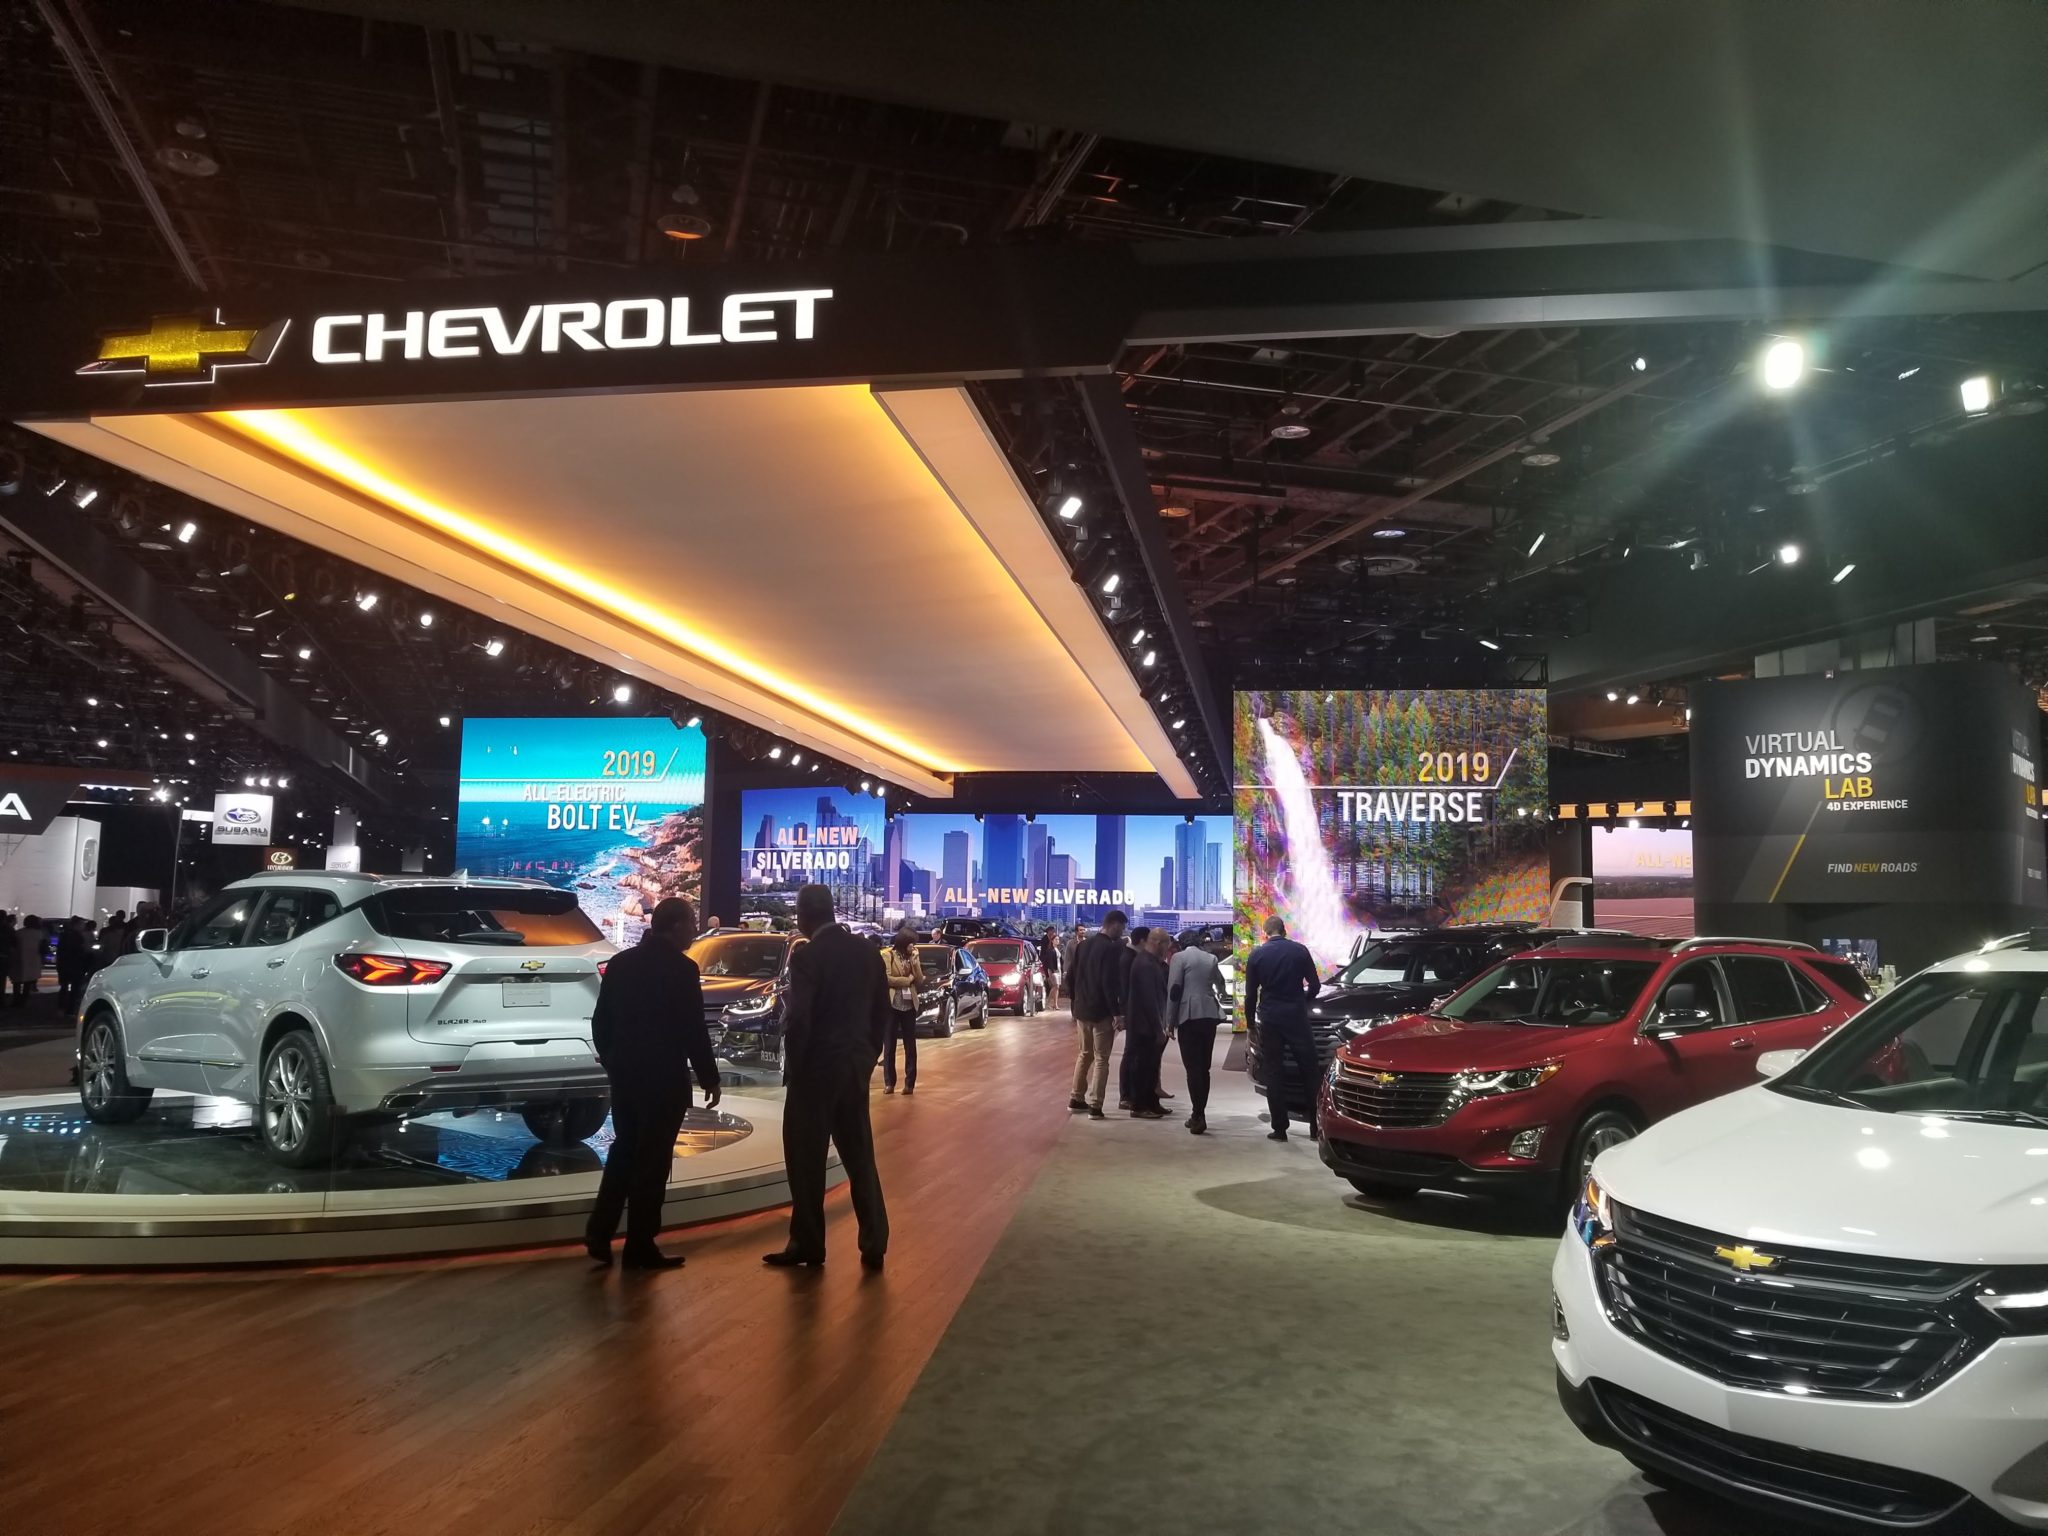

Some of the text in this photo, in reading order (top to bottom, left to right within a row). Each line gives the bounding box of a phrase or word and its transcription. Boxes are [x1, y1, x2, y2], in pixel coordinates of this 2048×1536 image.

[312, 288, 834, 365] CHEVROLET
[1745, 730, 1844, 755] VIRTUAL
[603, 750, 656, 777] 2019
[1418, 751, 1490, 783] 2019
[1745, 752, 1872, 779] DYNAMICS
[523, 783, 626, 802] ALL-ELECTRIC
[1824, 776, 1873, 799] LAB
[547, 803, 638, 830] BOLT EV
[1336, 791, 1483, 823] TRAVERSE
[1826, 800, 1908, 811] 4D EXPERIENCE
[217, 825, 268, 836] SUBARU
[777, 826, 859, 847] ALL-NEW
[756, 851, 850, 870] SILVERADO
[1827, 862, 1917, 873] FIND NEW ROADS
[945, 887, 1135, 905] ALL-NEW SILVERADO
